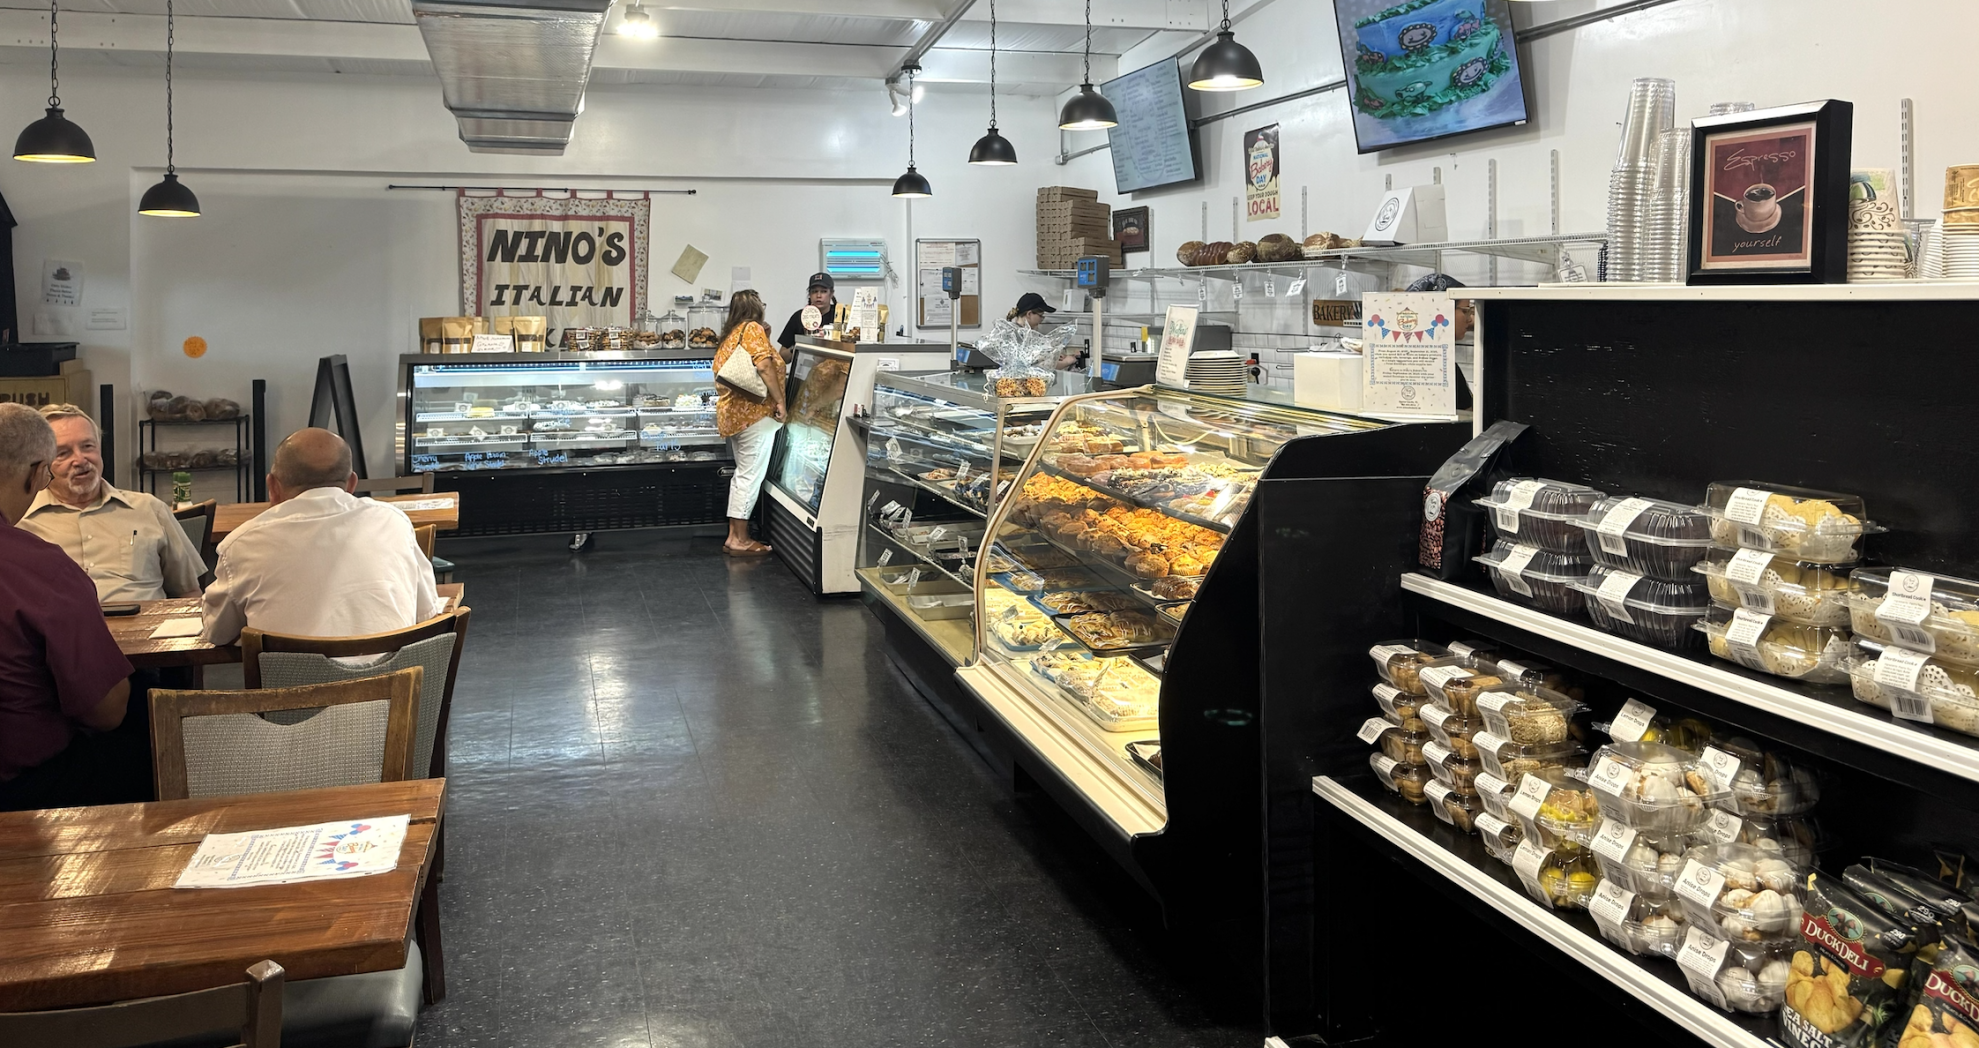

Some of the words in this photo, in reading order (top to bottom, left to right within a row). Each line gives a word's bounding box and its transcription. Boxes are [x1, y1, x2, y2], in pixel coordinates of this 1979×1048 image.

[1723, 148, 1796, 171] Espresso
[1255, 174, 1267, 185] DAY
[1264, 189, 1278, 198] DOUGH
[1247, 196, 1279, 217] LOCAL
[486, 226, 626, 266] NINO'S
[1732, 235, 1782, 253] yourself
[490, 284, 624, 308] ITALIAN
[1313, 304, 1354, 321] BAKERY
[1802, 1020, 1833, 1048] SALT
